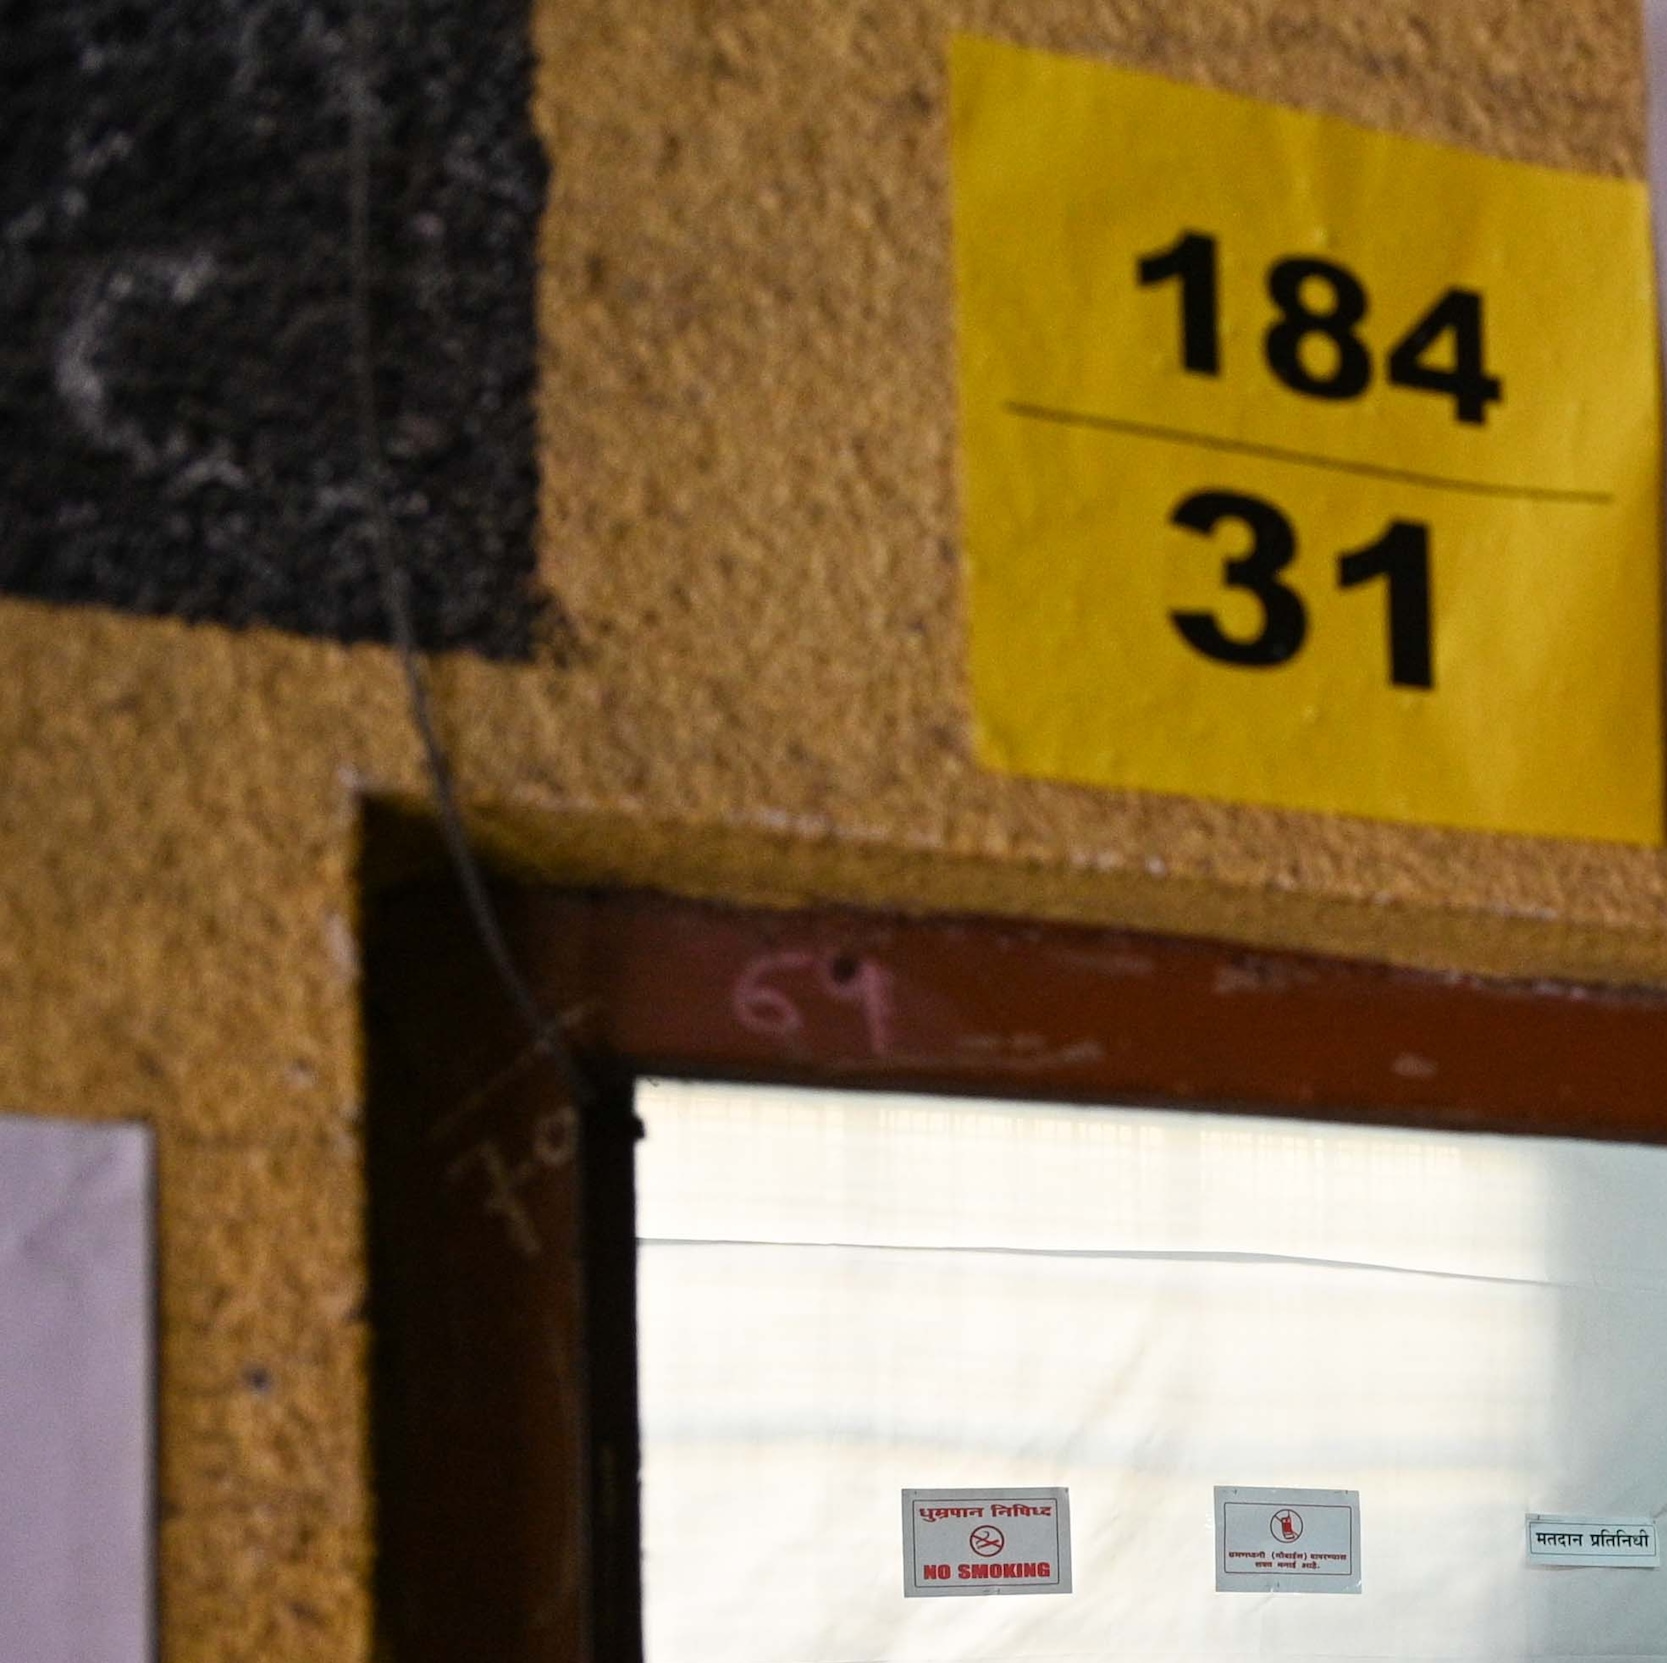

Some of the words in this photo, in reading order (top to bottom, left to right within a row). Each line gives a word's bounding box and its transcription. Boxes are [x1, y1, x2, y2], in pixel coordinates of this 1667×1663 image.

[1136, 228, 1503, 426] 184
[1169, 487, 1436, 693] 31
[923, 1564, 951, 1580] NO
[958, 1562, 1050, 1579] SMOKING
[1536, 1532, 1583, 1547] मतदान
[1589, 1529, 1649, 1547] प्रतिनिधी
